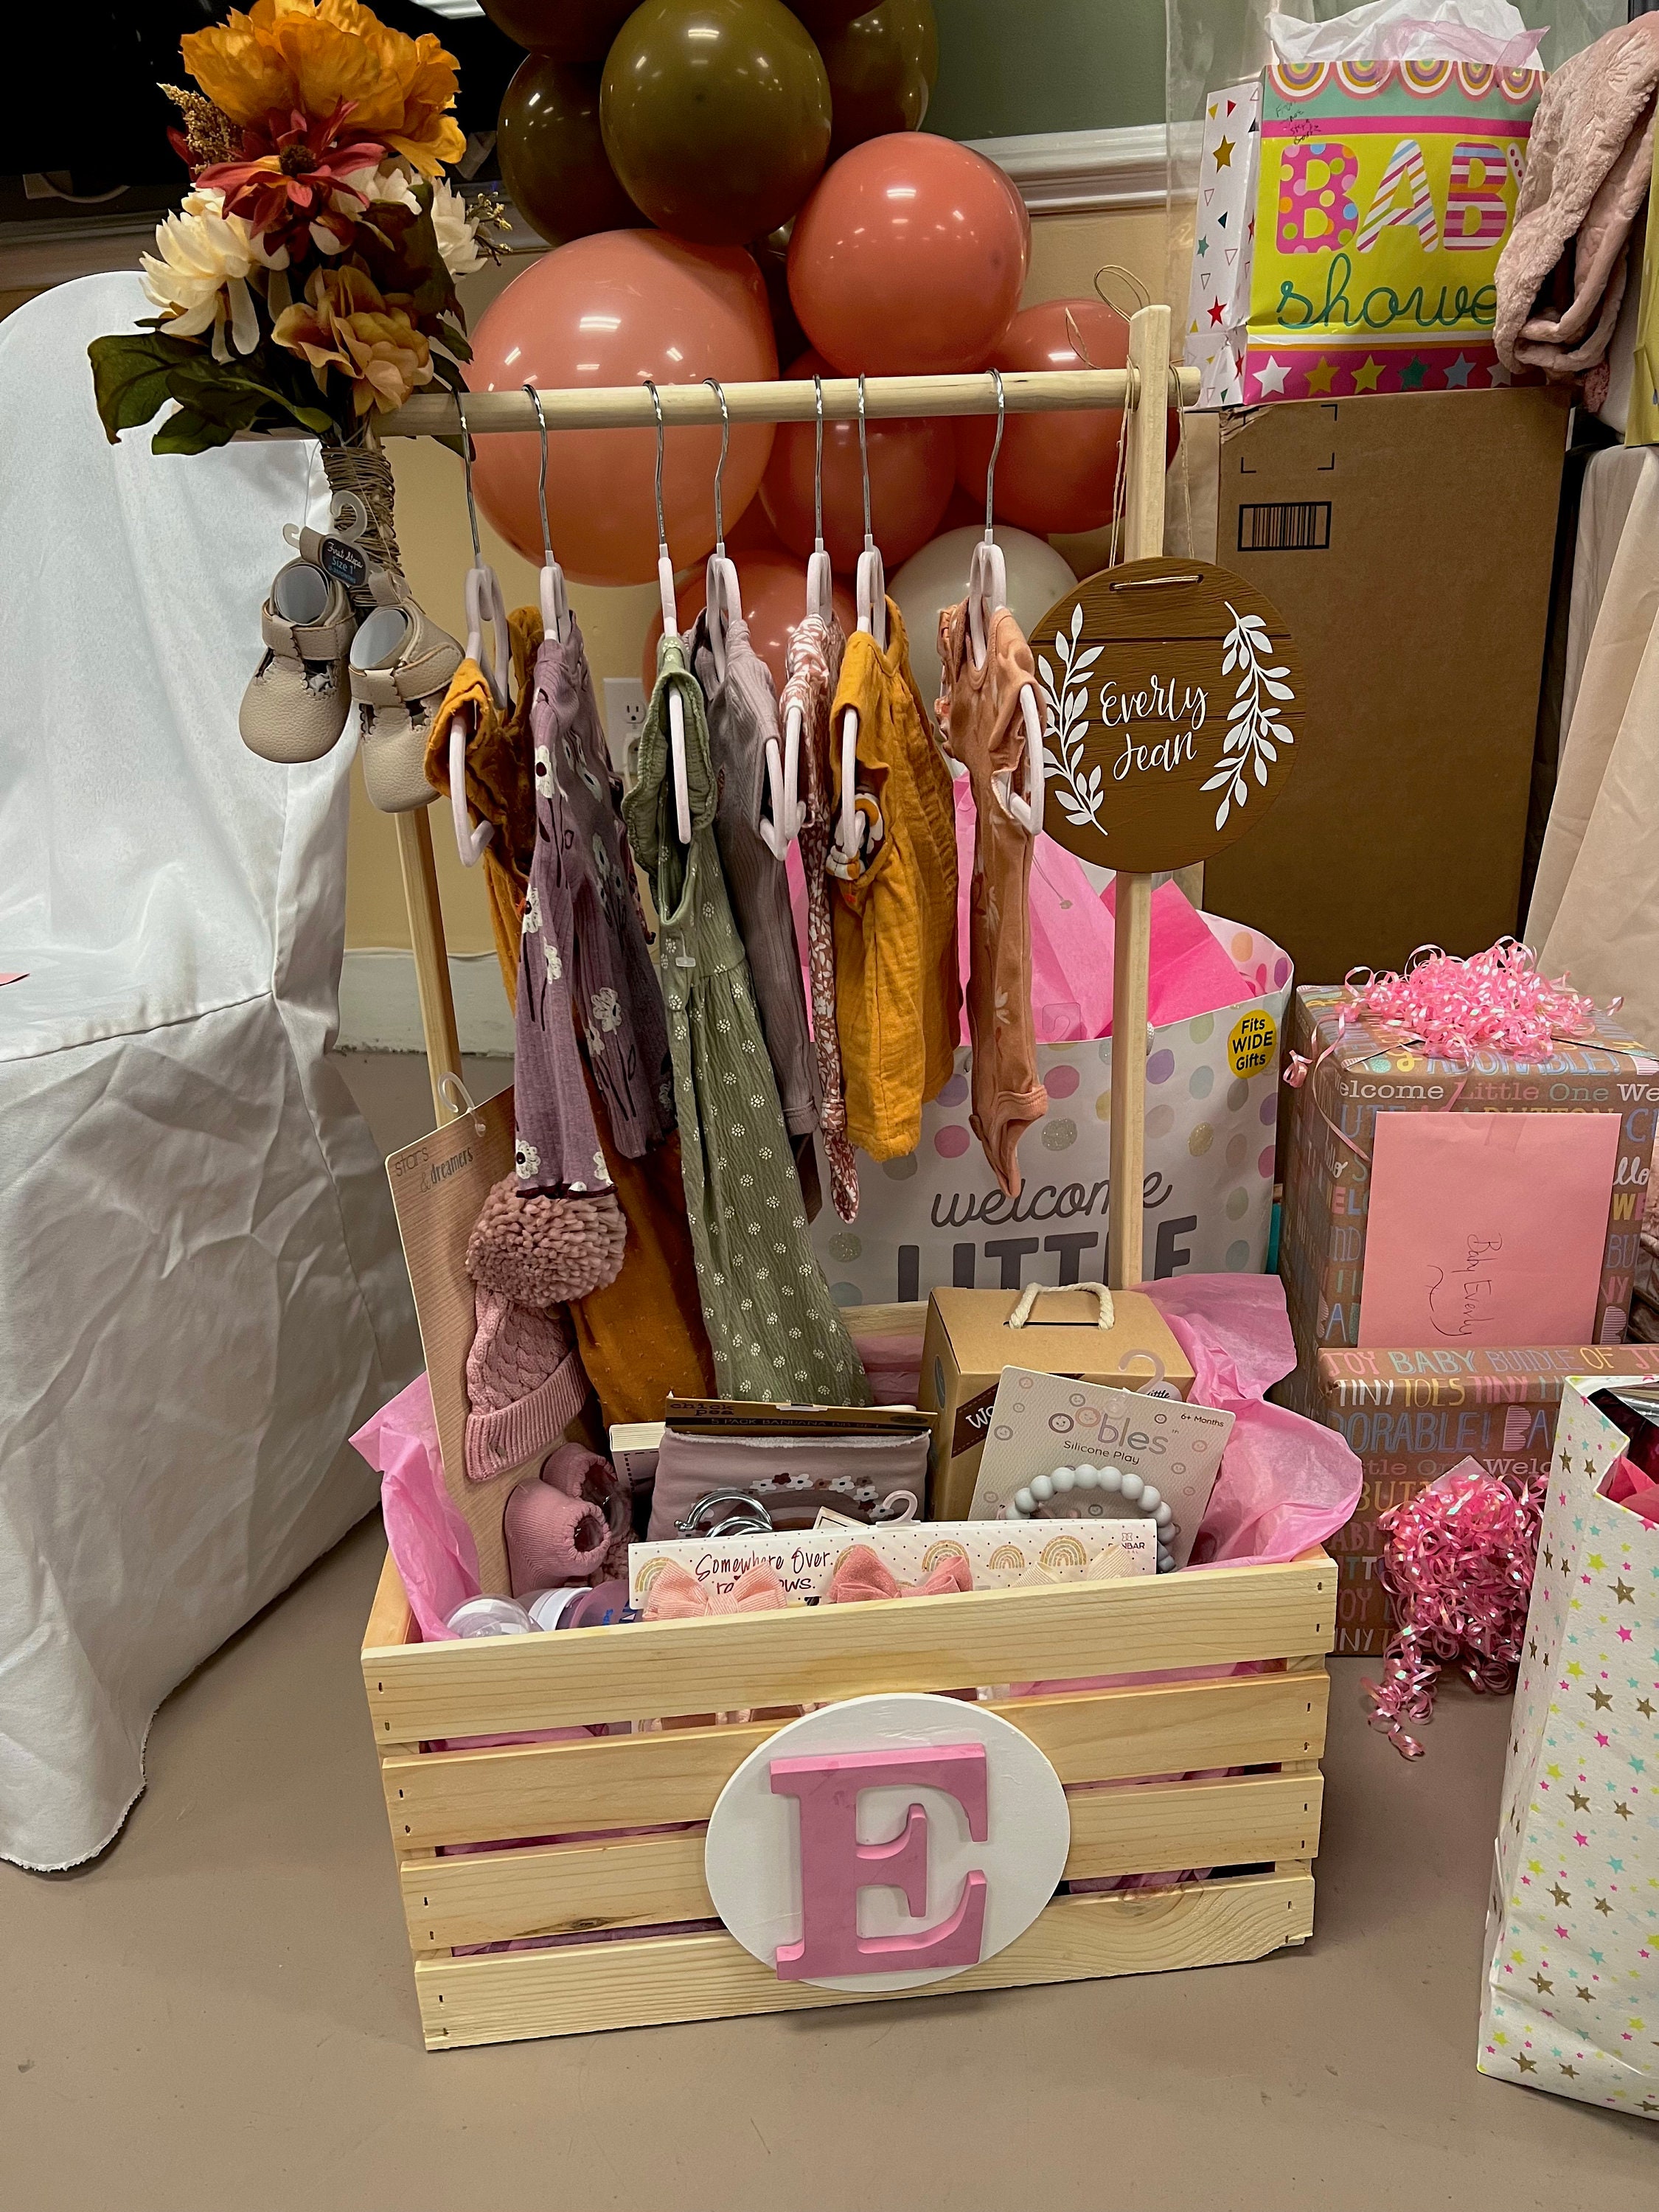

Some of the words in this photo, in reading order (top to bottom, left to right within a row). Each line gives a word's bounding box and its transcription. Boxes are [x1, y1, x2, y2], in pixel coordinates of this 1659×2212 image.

[1276, 139, 1523, 254] BAB
[1276, 253, 1497, 329] showe
[332, 556, 348, 571] Size
[1099, 674, 1209, 731] Everly
[1113, 731, 1197, 781] Jean
[1241, 1018, 1266, 1034] Fits
[1232, 1030, 1273, 1054] WIDE
[1236, 1053, 1266, 1071] Gifts
[1549, 1082, 1610, 1102] One
[394, 1147, 430, 1178] stars
[420, 1172, 432, 1193] &
[430, 1147, 474, 1185] dreamers
[897, 1214, 1197, 1298] LITTE
[1451, 1232, 1503, 1273] Baby
[1440, 1279, 1495, 1337] Everly
[1388, 1349, 1478, 1374] BABY
[1485, 1349, 1585, 1373] BUNDLE
[1579, 1346, 1615, 1369] OF
[1146, 1388, 1170, 1399] ittle
[1333, 1379, 1394, 1407] TINY
[1397, 1377, 1466, 1408] TOES
[1466, 1375, 1528, 1404] TINY
[670, 1402, 735, 1411] chick
[695, 1408, 734, 1416] pea
[965, 1405, 994, 1429] Wo
[1180, 1412, 1192, 1421] 6+
[1193, 1414, 1225, 1428] Months
[1048, 1405, 1169, 1455] oobles
[1063, 1439, 1110, 1458] Silicone
[1112, 1450, 1141, 1466] Play
[770, 1742, 988, 1980] E
